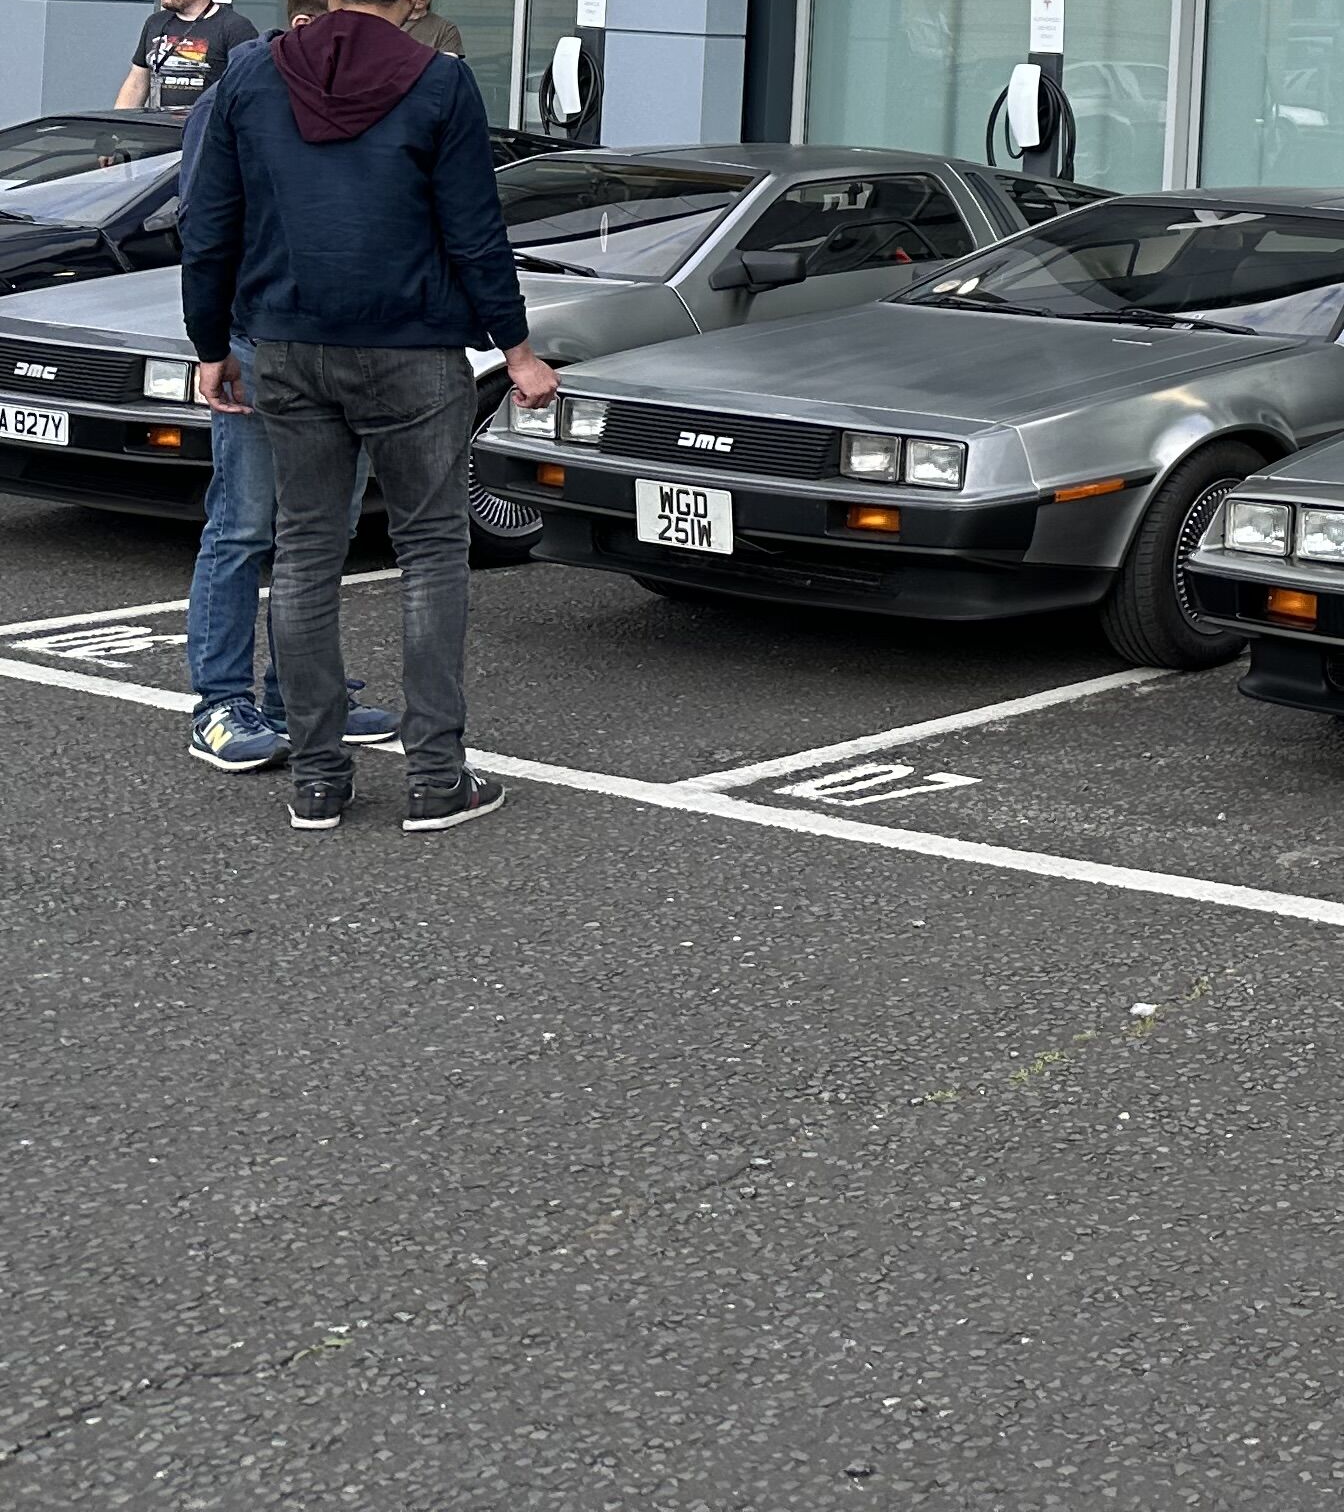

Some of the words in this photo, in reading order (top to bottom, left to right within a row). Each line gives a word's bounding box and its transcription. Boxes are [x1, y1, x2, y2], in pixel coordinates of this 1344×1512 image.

[13, 361, 58, 380] DMC
[14, 410, 62, 439] 827Y
[677, 431, 734, 453] DMC
[658, 485, 708, 519] WGD
[657, 513, 712, 548] 251W
[772, 763, 984, 807] 07
